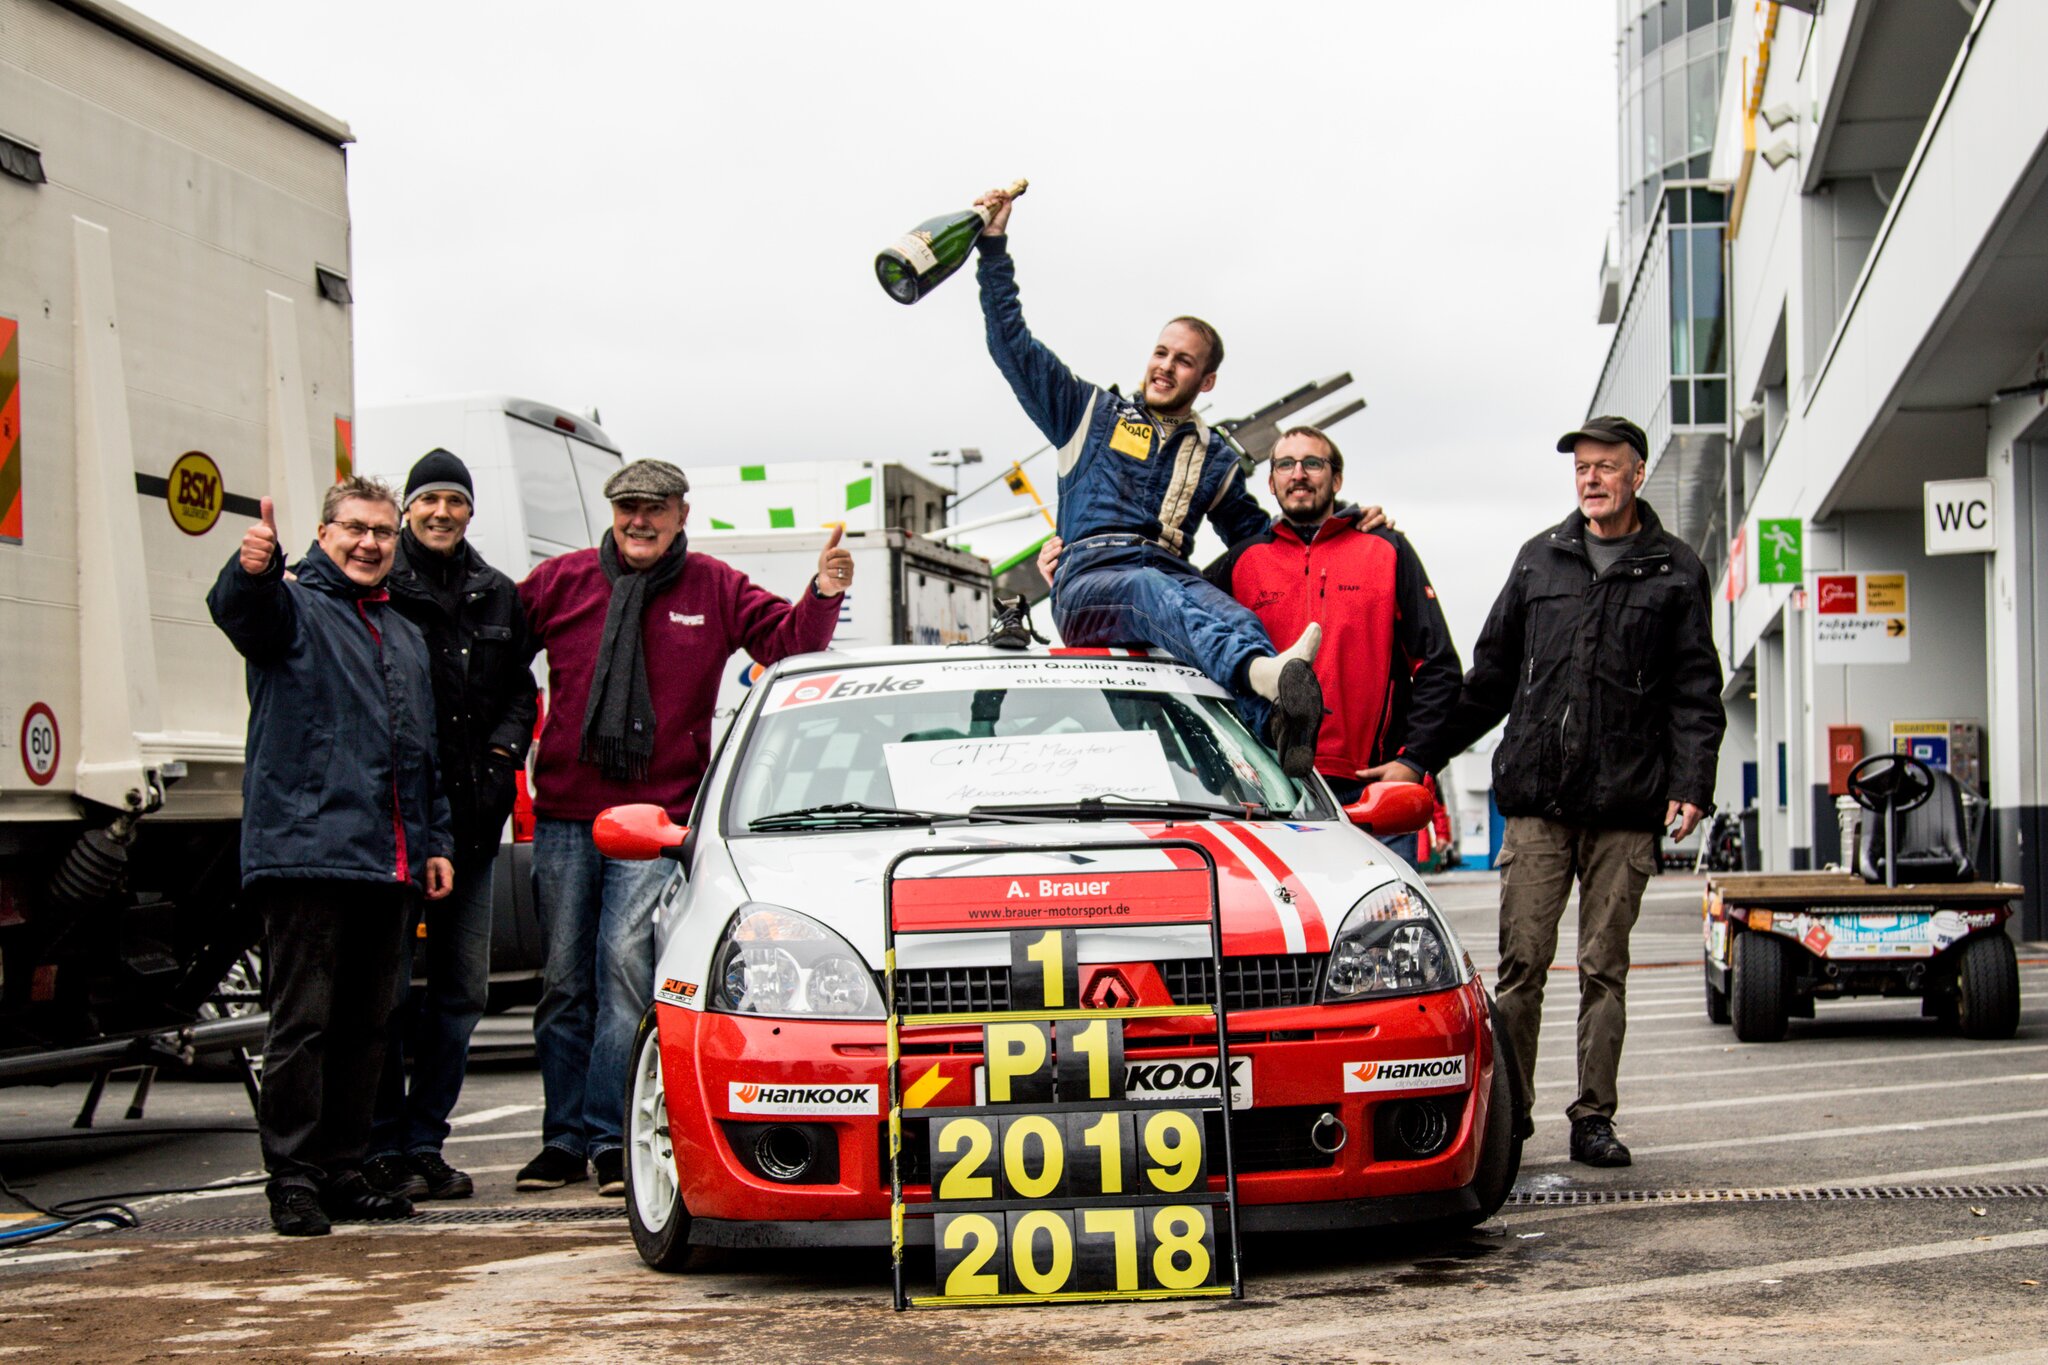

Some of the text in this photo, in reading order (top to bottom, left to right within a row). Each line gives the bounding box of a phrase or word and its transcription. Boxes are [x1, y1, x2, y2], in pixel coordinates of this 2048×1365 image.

[1120, 420, 1151, 440] ADAC
[178, 467, 217, 511] BSM
[1936, 501, 1988, 531] WC
[941, 662, 1038, 674] Produziert
[1045, 662, 1119, 672] Qualität
[1127, 664, 1156, 673] seit
[829, 675, 925, 699] Enke
[1016, 677, 1148, 687] enke-werk.de
[31, 727, 52, 755] 60
[987, 758, 1079, 777] 2019
[1007, 879, 1110, 898] A. Brauer
[968, 903, 1130, 919] www.brauer-motorsport.de
[1027, 930, 1065, 1007] 1
[938, 1111, 1202, 1199] 2019
